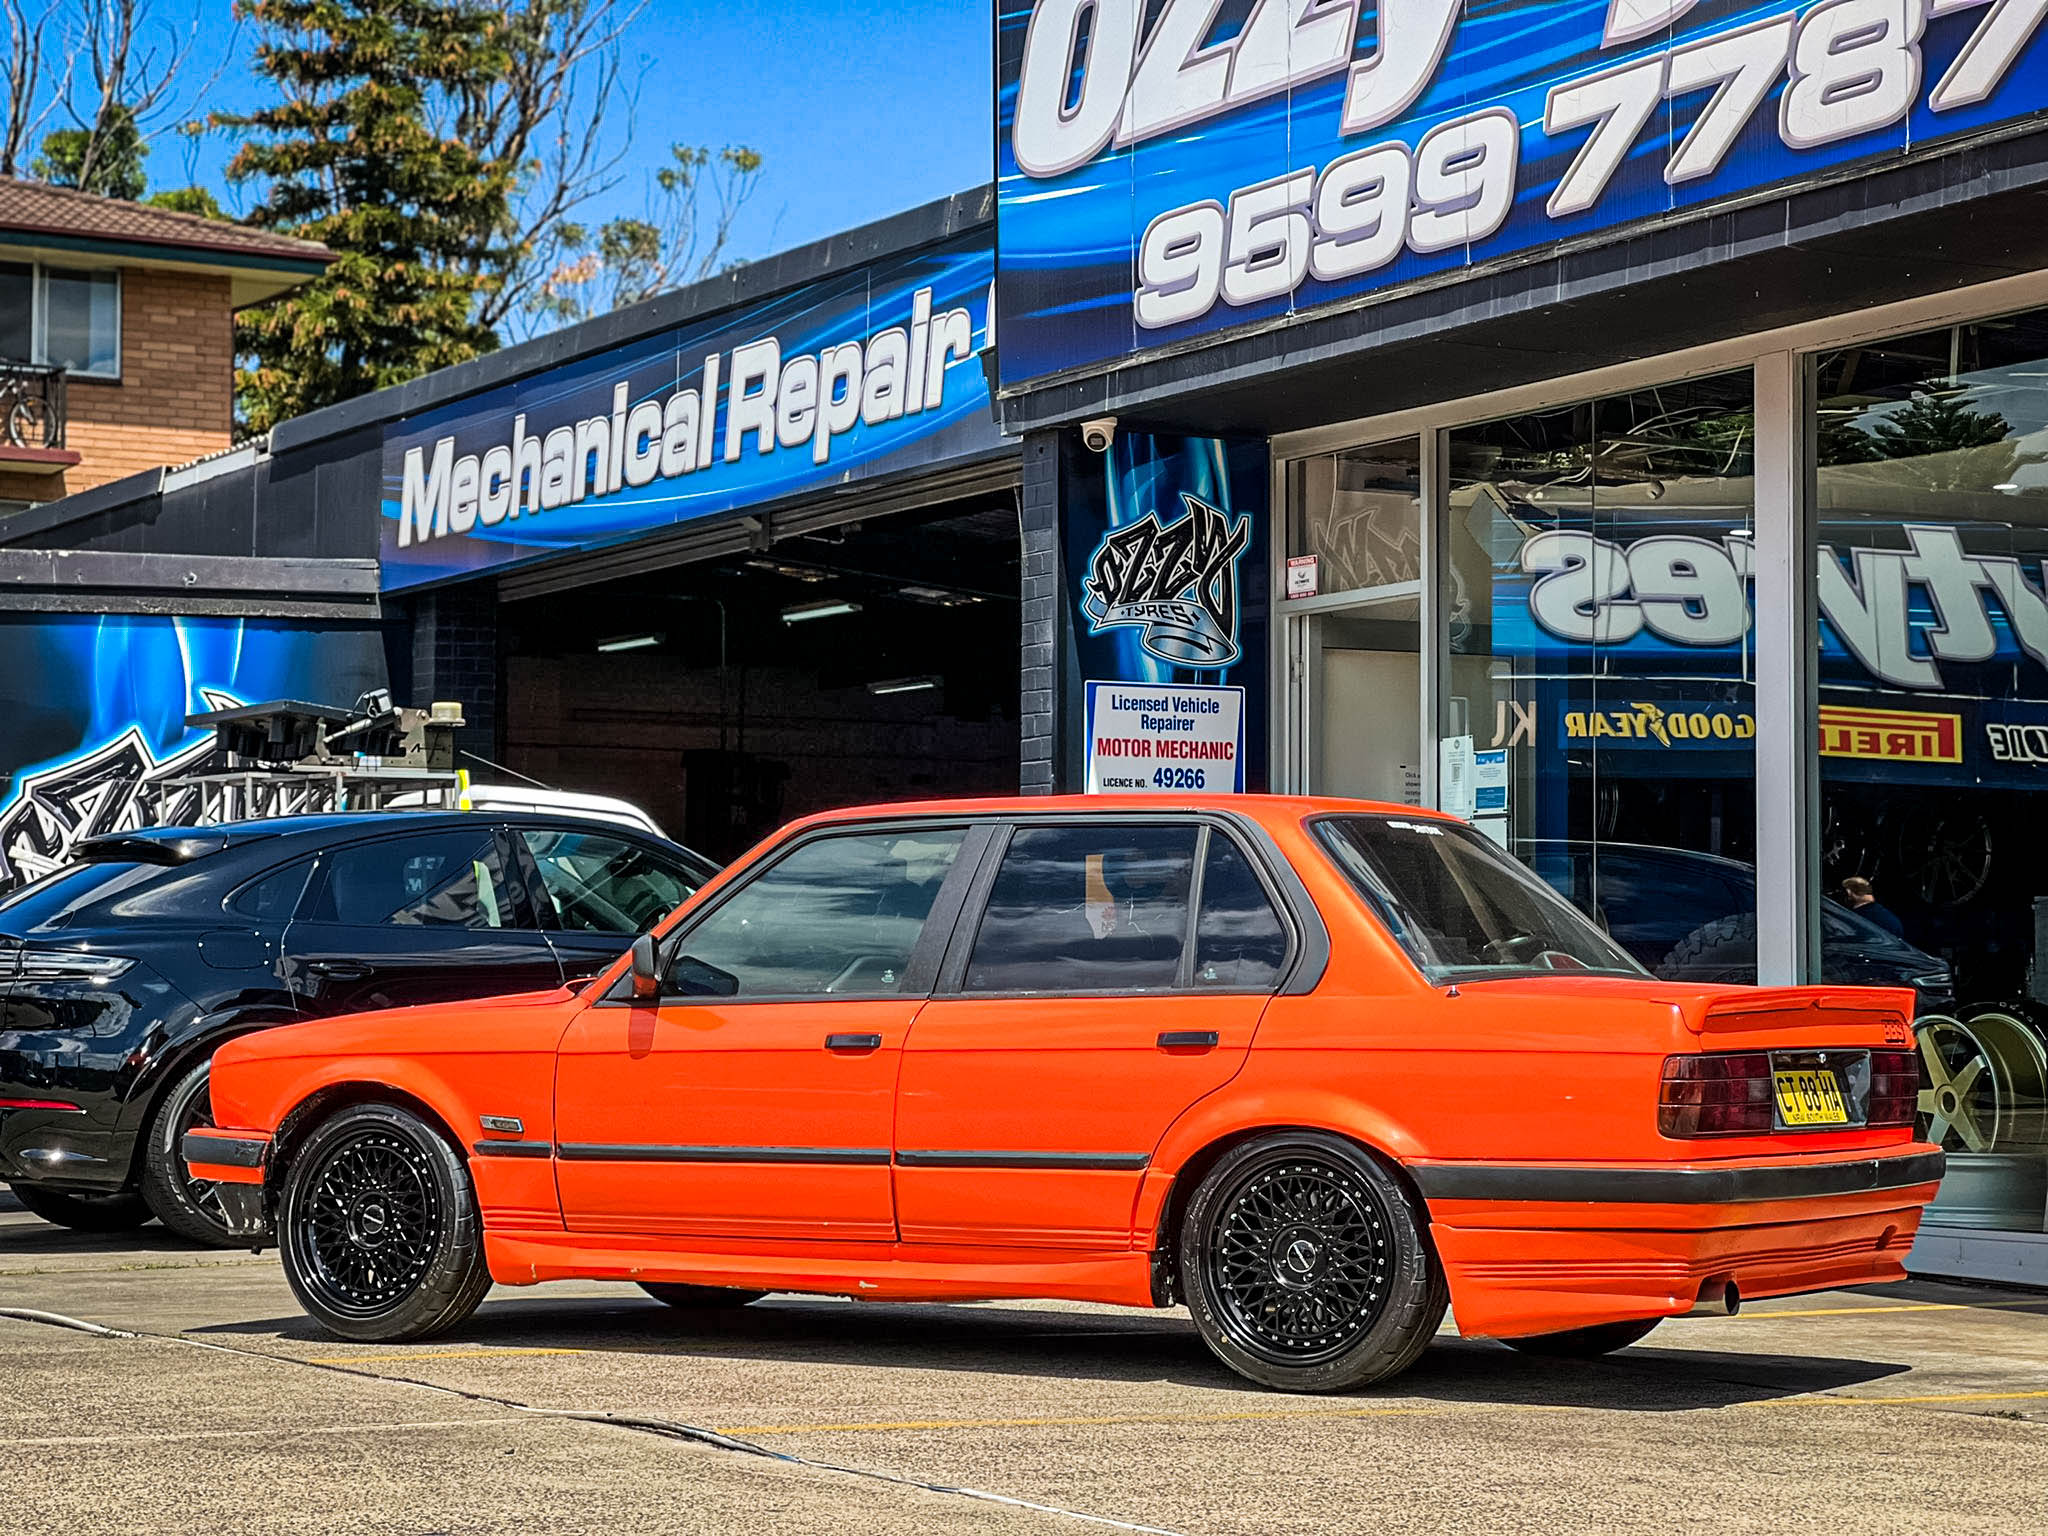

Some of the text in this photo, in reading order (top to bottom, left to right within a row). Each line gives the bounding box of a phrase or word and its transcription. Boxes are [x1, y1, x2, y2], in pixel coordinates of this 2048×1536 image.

[1134, 0, 2048, 329] 9599 7787
[397, 286, 972, 549] Mechanical Repair
[1125, 603, 1195, 627] TYRES
[1112, 694, 1220, 714] Licensed Vehicle
[1141, 714, 1195, 734] Repairer
[1097, 738, 1234, 760] MOTOR MECHANIC
[1103, 767, 1205, 789] LICENCE NO. 49266
